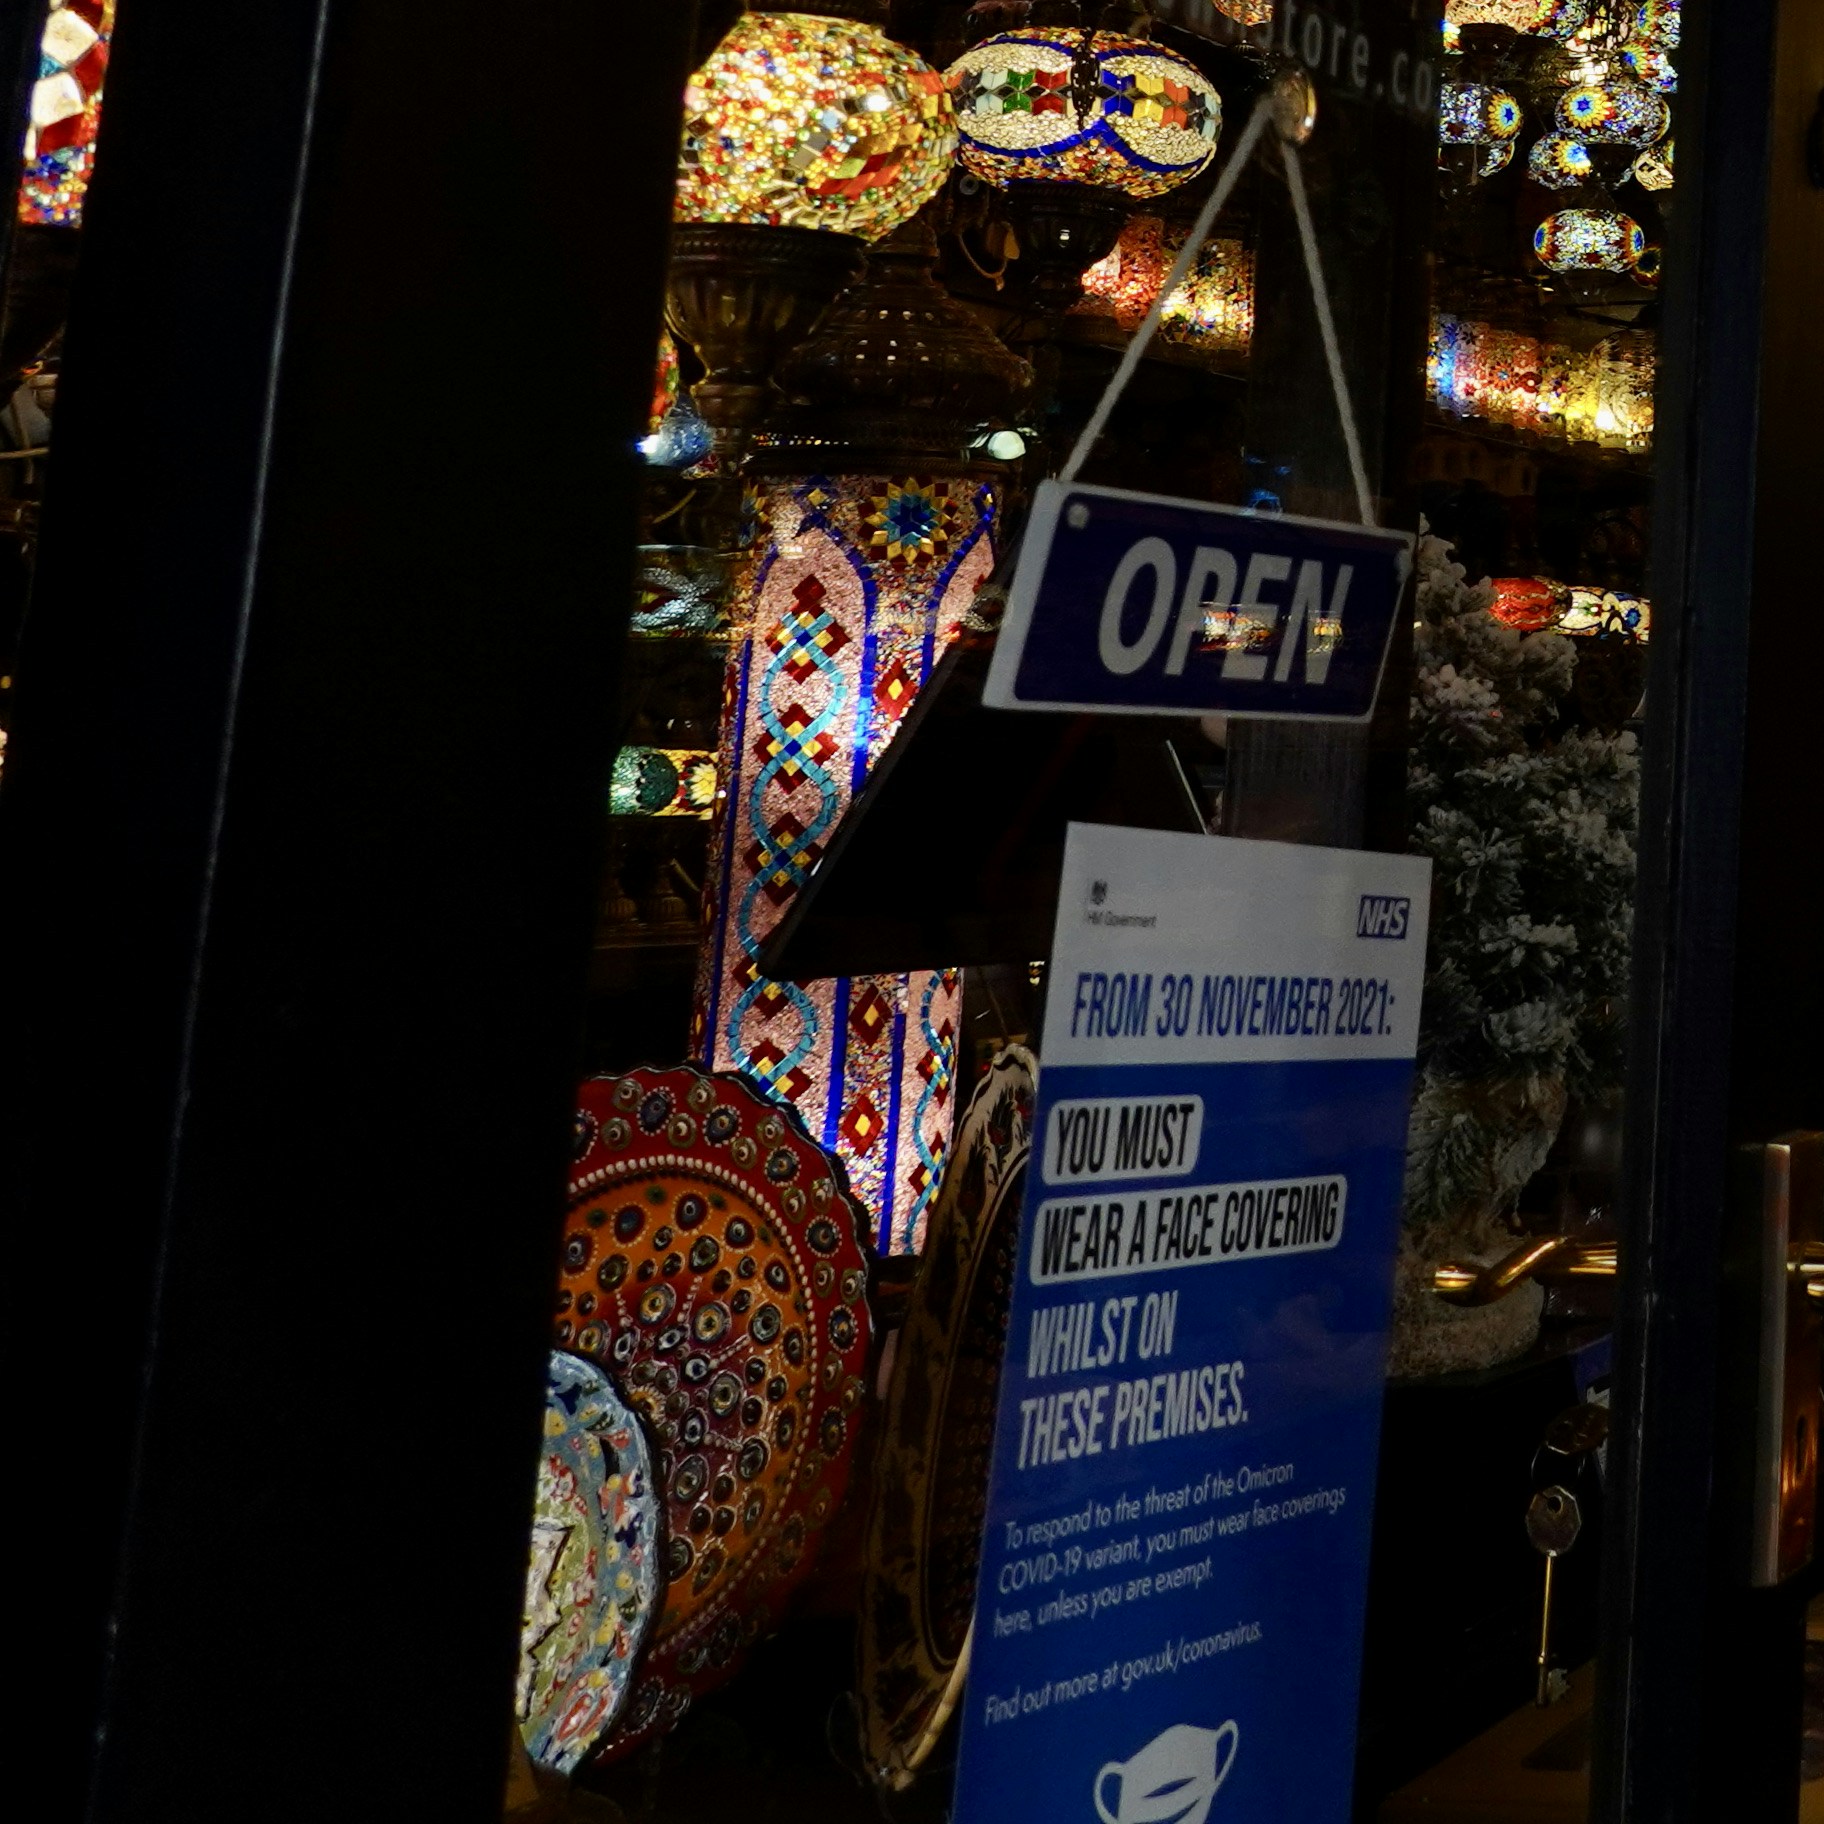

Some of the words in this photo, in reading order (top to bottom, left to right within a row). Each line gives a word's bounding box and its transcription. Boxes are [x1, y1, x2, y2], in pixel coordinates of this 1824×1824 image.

[1097, 535, 1355, 686] OPEN
[1360, 897, 1408, 937] NHS
[1072, 973, 1152, 1037] FROM
[1157, 976, 1193, 1036] 30
[1198, 975, 1332, 1036] NOVEMBER
[1336, 978, 1395, 1036] 2021:
[1056, 1108, 1110, 1175] YOU
[1115, 1104, 1194, 1170] MUST
[1041, 1200, 1124, 1275] WEAR
[1127, 1201, 1147, 1265] A
[1152, 1193, 1218, 1262] FACE
[1221, 1182, 1339, 1252] COVERING
[1027, 1293, 1138, 1379] WHILST
[1139, 1290, 1179, 1360] ON
[1017, 1386, 1110, 1470] THESE
[1109, 1361, 1248, 1451] PREMISES.
[999, 1545, 1082, 1595] COVID-19
[1146, 1532, 1177, 1564] you
[1179, 1518, 1216, 1548] must
[1218, 1512, 1250, 1537] wear
[1252, 1501, 1279, 1529] face
[1281, 1486, 1347, 1520] coverings
[1006, 1521, 1024, 1550] To
[1026, 1499, 1090, 1550] respond
[1096, 1506, 1112, 1527] to
[1115, 1491, 1141, 1522] the
[1144, 1485, 1192, 1518] threat
[1194, 1474, 1212, 1505] of
[1212, 1470, 1234, 1501] the
[1236, 1462, 1294, 1494] Omicron
[993, 1608, 1034, 1639] here,
[1036, 1591, 1088, 1625] unless
[1091, 1583, 1122, 1620] you
[1125, 1577, 1152, 1602] are
[1154, 1556, 1214, 1594] exempt.
[984, 1694, 1020, 1728] Find
[1022, 1686, 1051, 1716] out
[1053, 1671, 1098, 1704] more
[1101, 1663, 1119, 1690] at
